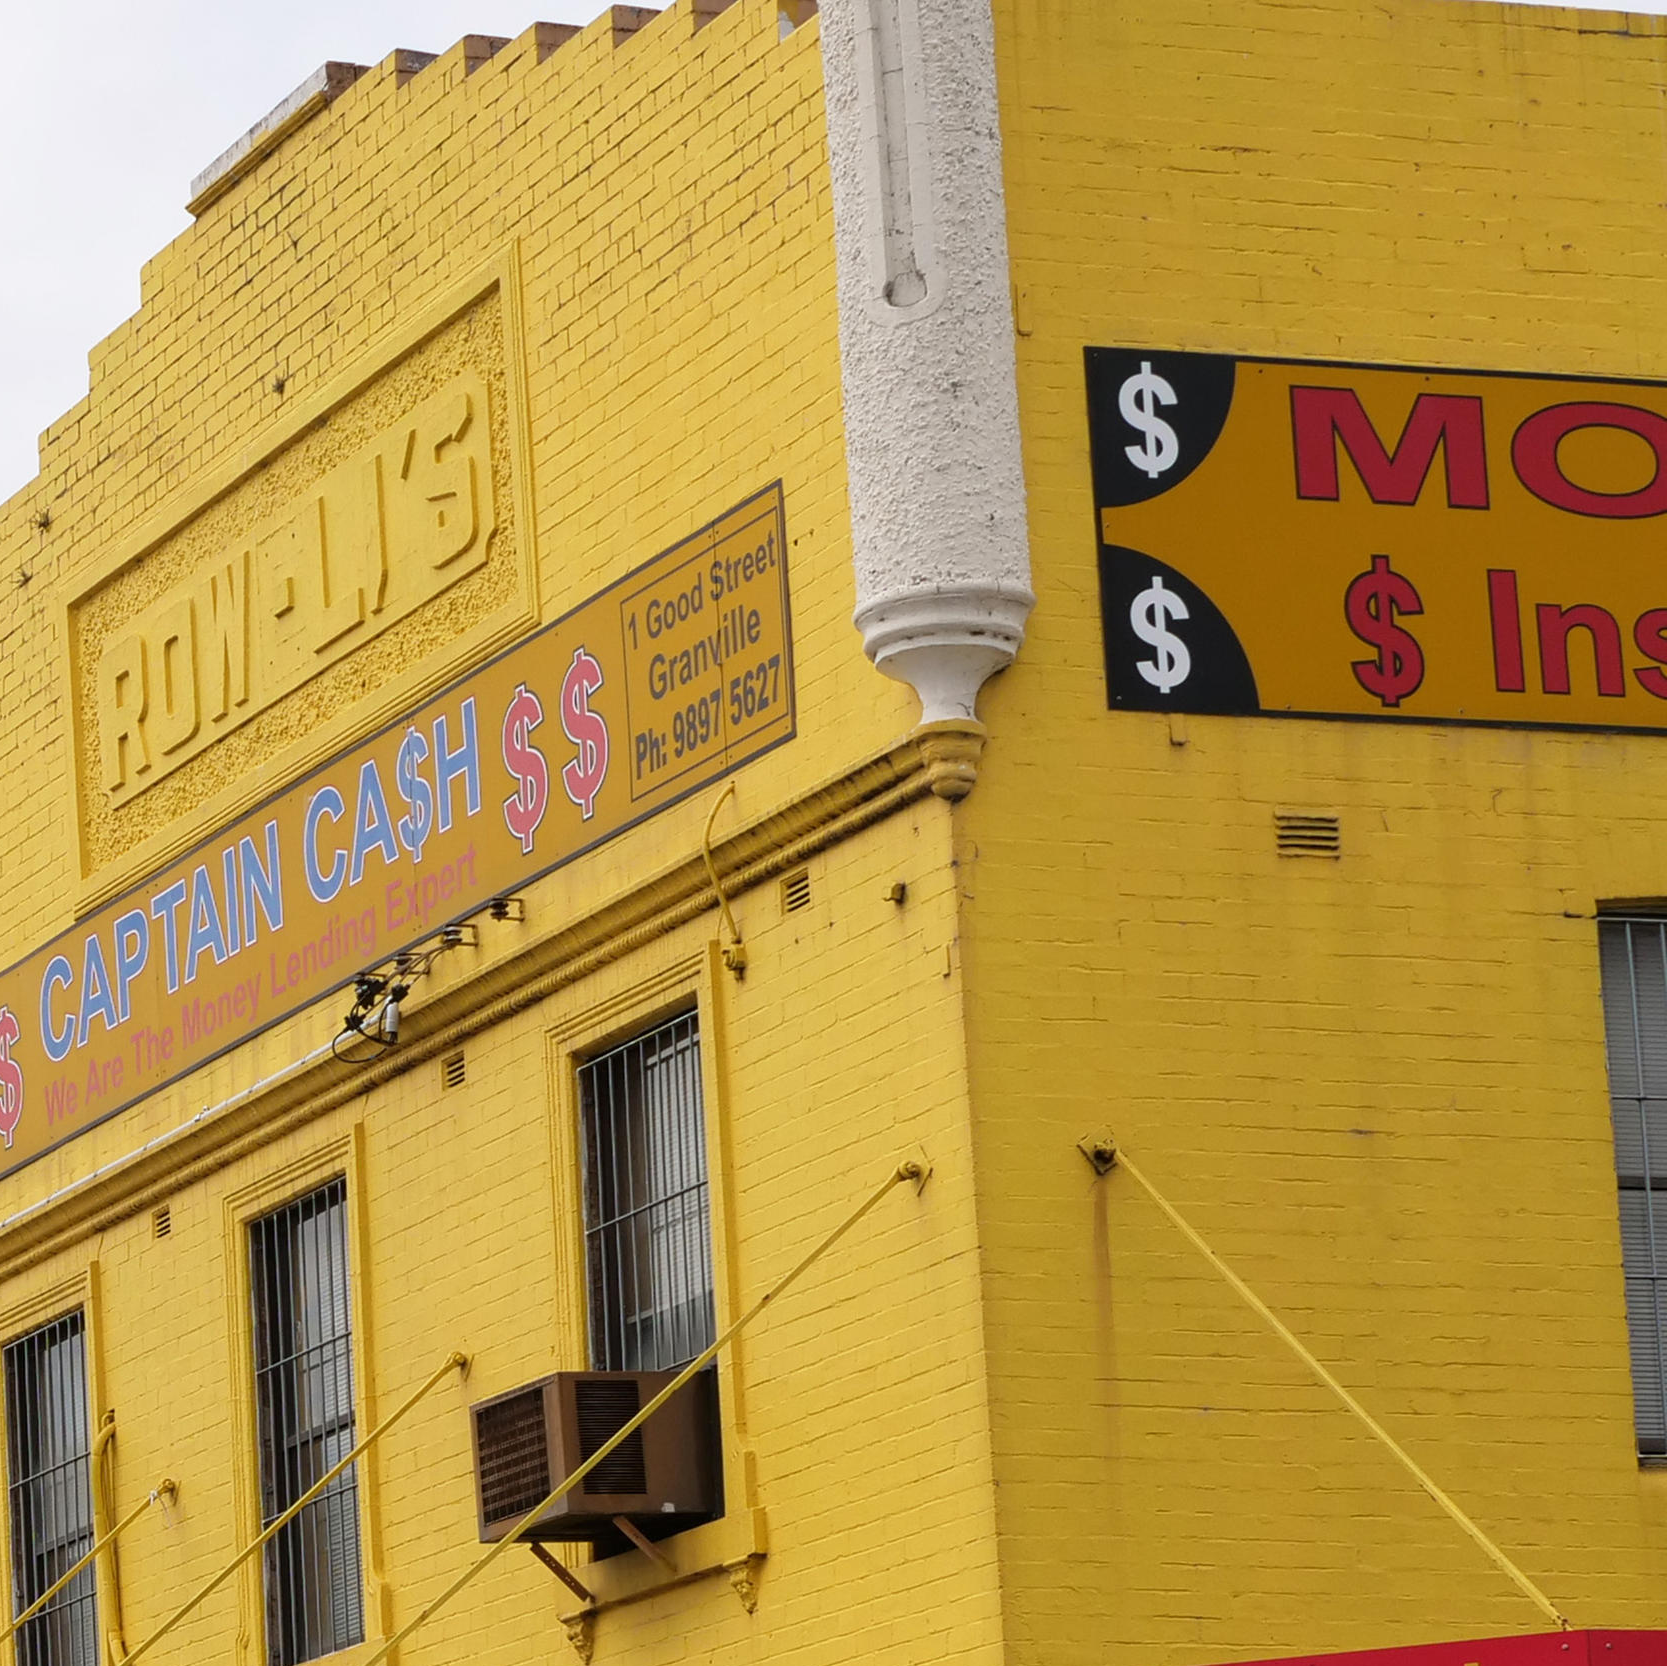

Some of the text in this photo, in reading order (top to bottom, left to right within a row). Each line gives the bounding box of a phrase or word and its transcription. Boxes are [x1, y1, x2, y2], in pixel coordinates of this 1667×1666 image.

[1288, 385, 1667, 520] MO
[628, 529, 778, 651] 1 Good Street
[648, 607, 762, 703] Granville
[635, 653, 783, 782] Ph: 9897 5627
[37, 818, 284, 1064] CAPTAIN
[302, 694, 482, 906] CA$H
[44, 842, 479, 1128] We Are The Money Lending Expert
